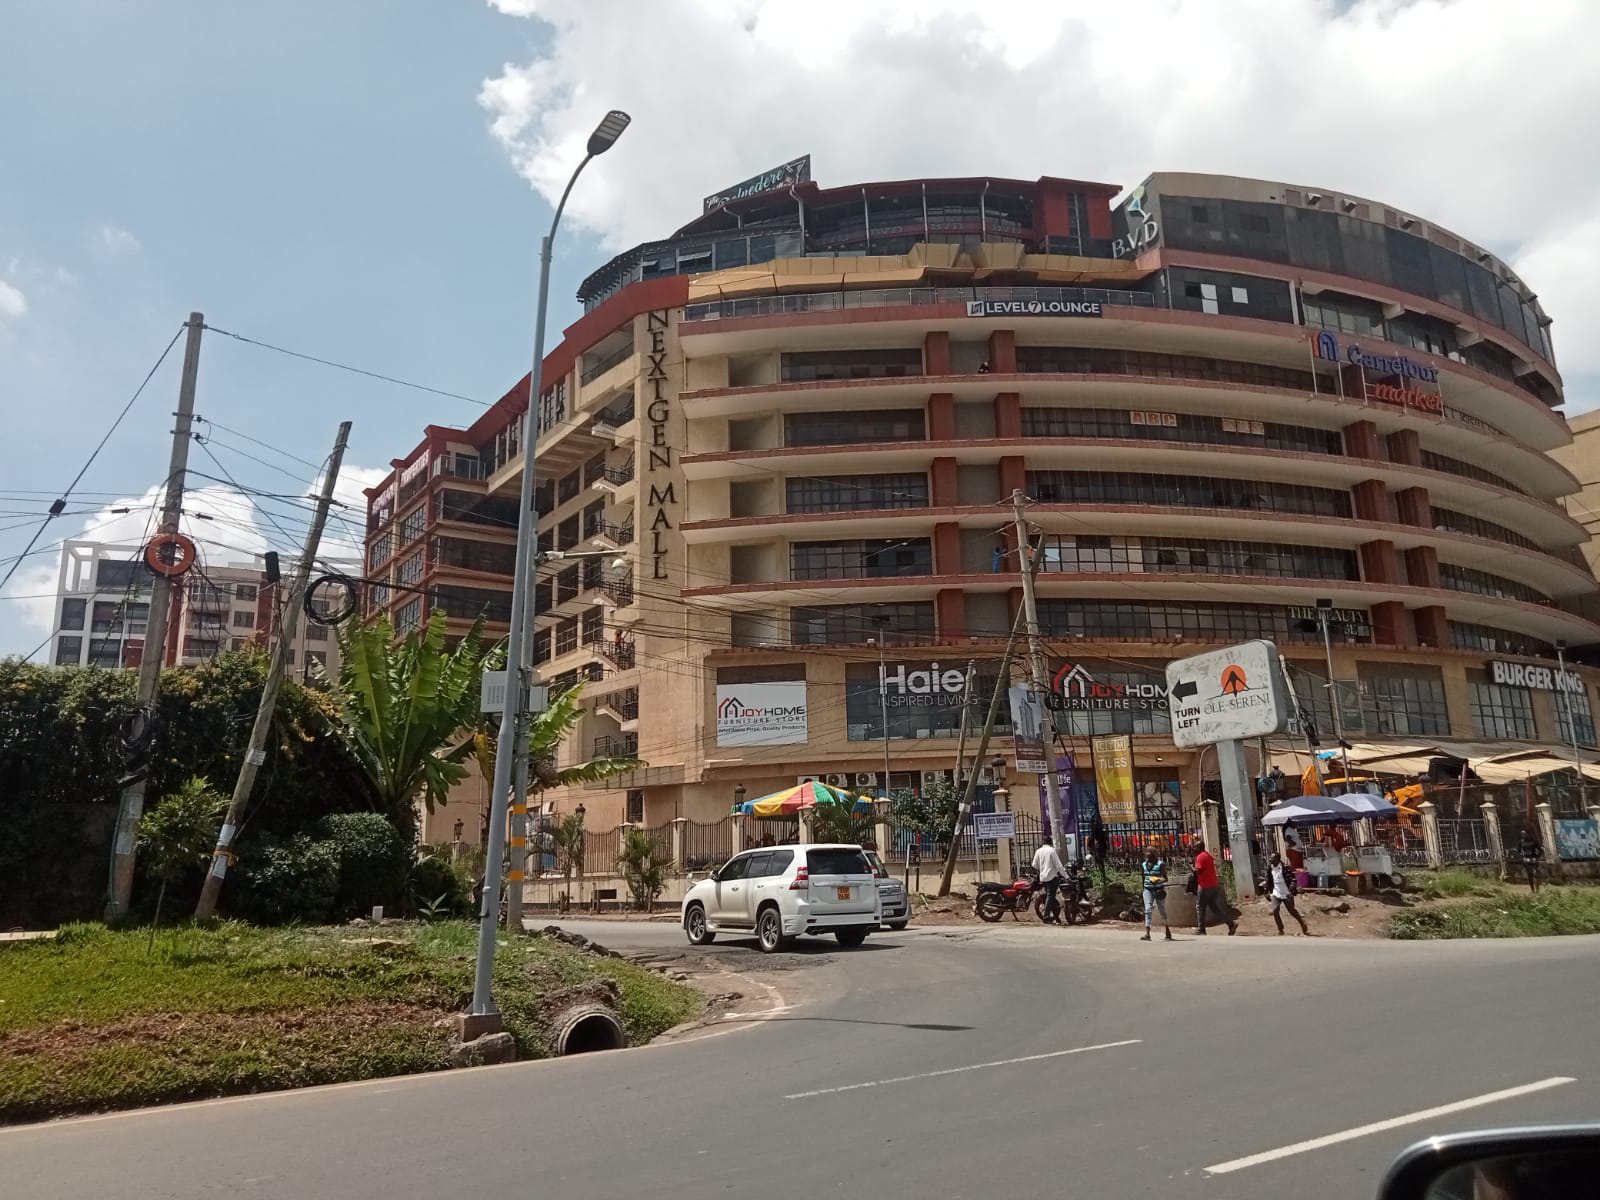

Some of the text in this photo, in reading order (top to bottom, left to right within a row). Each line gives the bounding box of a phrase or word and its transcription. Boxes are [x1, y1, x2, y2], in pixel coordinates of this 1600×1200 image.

[986, 302, 1028, 313] LEVEL
[1043, 301, 1100, 314] LOUNGE
[1347, 344, 1439, 383] Carrefour
[1375, 383, 1441, 410] market
[648, 309, 677, 579] NEXTGEN MALL
[1287, 606, 1315, 619] THE
[879, 662, 975, 694] Haie
[1493, 661, 1584, 693] BURGER KNG
[1088, 684, 1169, 698] JOYHOM
[1140, 699, 1168, 709] STO
[1203, 693, 1270, 715] OLE SERENI
[740, 706, 805, 717] JOYHOME
[1175, 706, 1201, 719] TURN
[1178, 718, 1200, 729] LEFT
[1099, 757, 1128, 769] TILES
[1102, 801, 1132, 811] KARIBU
